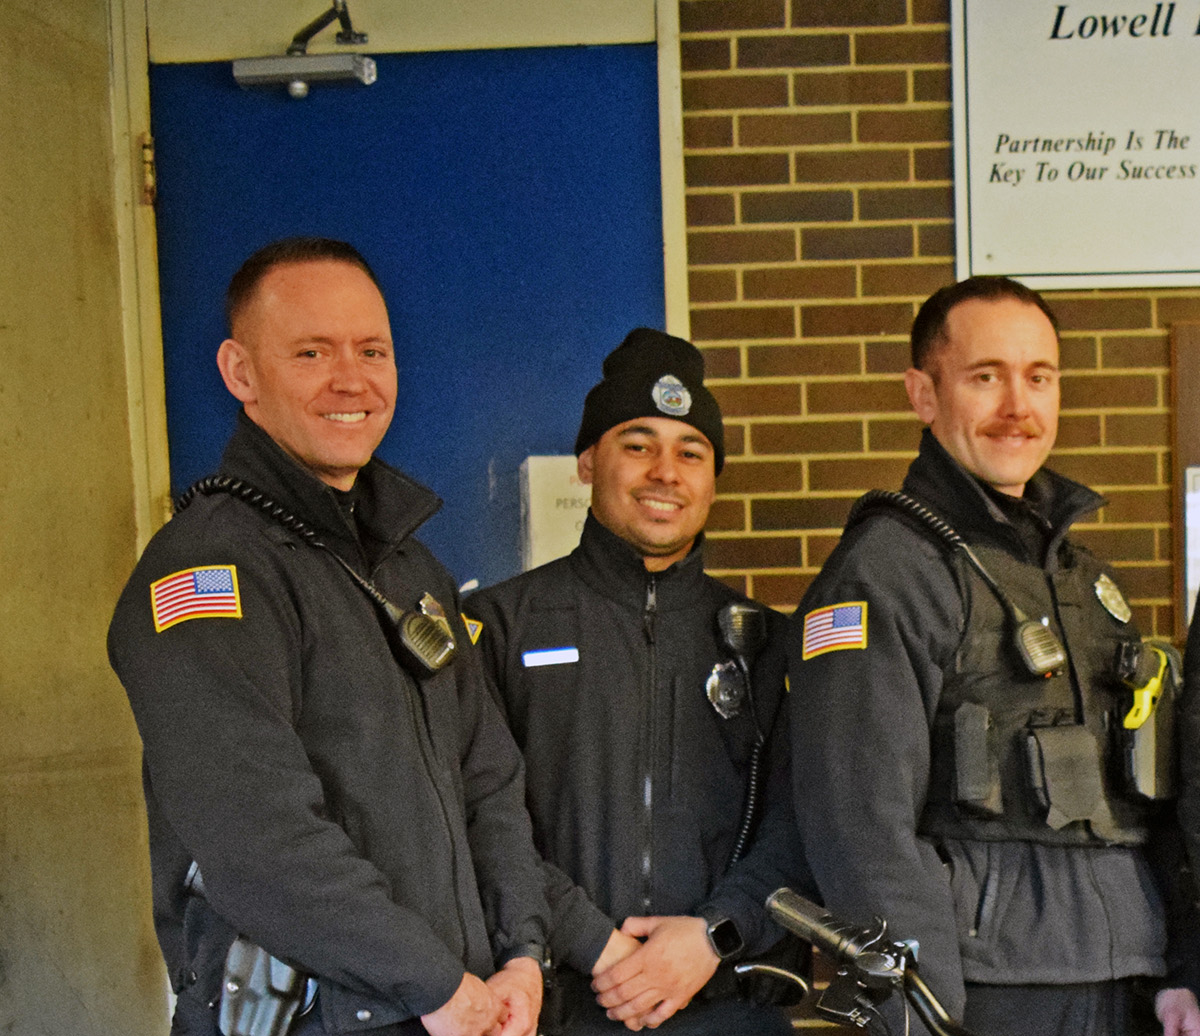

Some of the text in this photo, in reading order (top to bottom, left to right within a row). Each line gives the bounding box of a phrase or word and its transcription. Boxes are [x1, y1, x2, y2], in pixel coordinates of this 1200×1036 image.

[1048, 1, 1176, 40] Lowell
[994, 129, 1191, 156] Partnership Is The
[988, 158, 1199, 187] Key To Our Success
